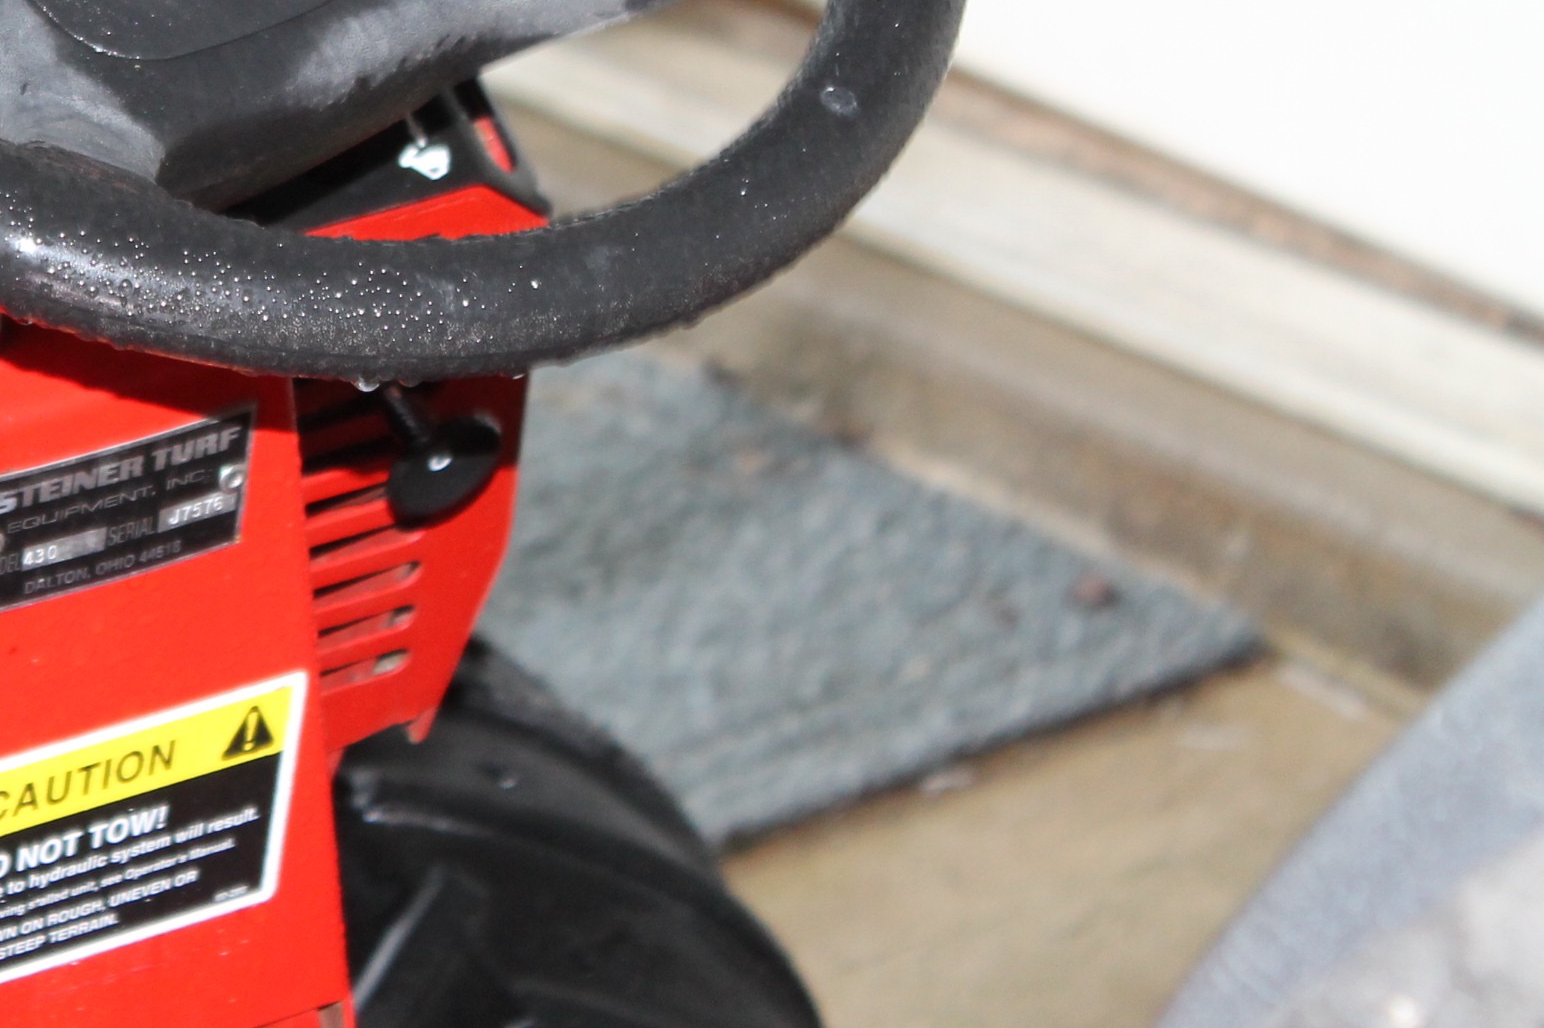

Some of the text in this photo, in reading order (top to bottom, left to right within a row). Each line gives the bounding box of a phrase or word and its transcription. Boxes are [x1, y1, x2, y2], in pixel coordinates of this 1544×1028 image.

[151, 427, 241, 471] TURF
[22, 544, 57, 565] 430
[107, 517, 155, 546] SERIAL
[95, 552, 137, 576] OHIO
[7, 880, 26, 895] to
[29, 853, 108, 889] hydraulic
[111, 836, 172, 865] system
[174, 822, 204, 844] will
[206, 804, 261, 834] result.
[16, 830, 84, 872] NOT
[89, 802, 170, 849] TOW!
[20, 917, 45, 936] ON
[108, 877, 172, 908] UNEVEN
[174, 868, 200, 889] OR
[28, 887, 70, 910] stalled
[71, 879, 99, 898] unit,
[100, 872, 123, 889] see
[125, 853, 188, 881] Operator's
[47, 913, 120, 944] TERRAIN.
